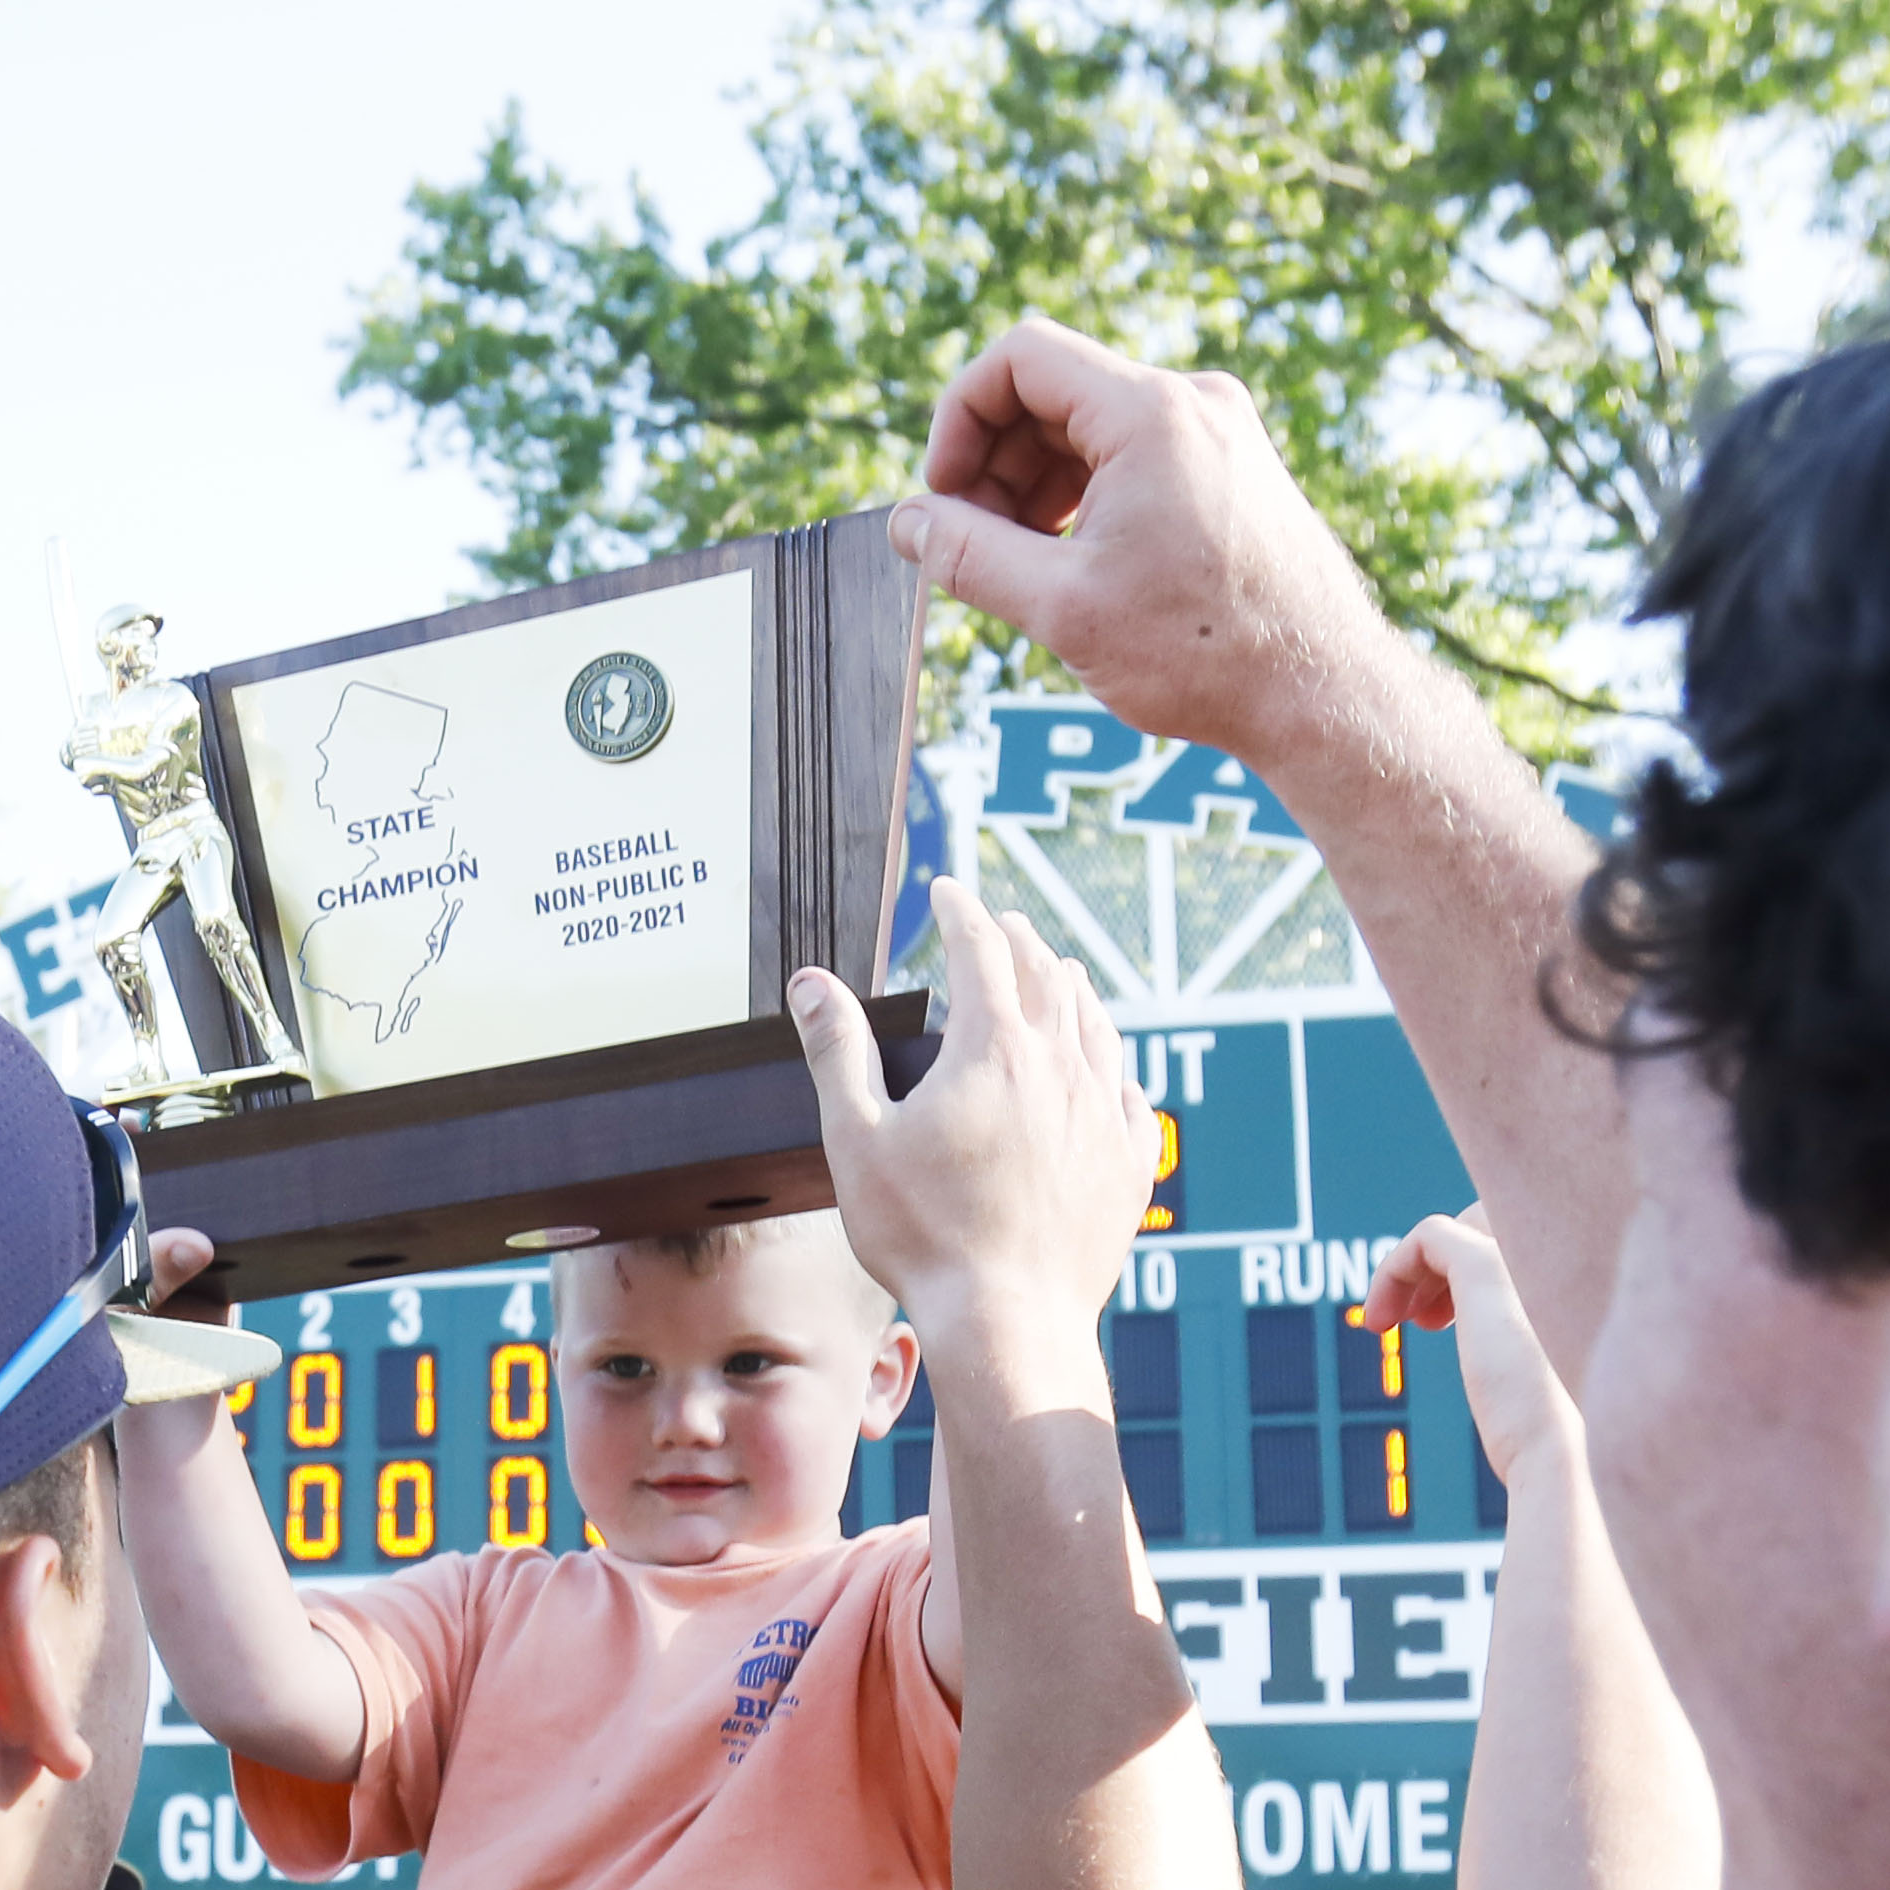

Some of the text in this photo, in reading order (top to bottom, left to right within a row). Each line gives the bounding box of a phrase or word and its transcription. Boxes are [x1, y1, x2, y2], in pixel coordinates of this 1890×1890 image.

[347, 805, 436, 845] STATE
[555, 829, 679, 875] BASEBALL
[316, 857, 479, 912] CHAMPION
[534, 859, 708, 915] NON-PUBLIC B
[562, 900, 685, 947] 2020-2021
[1123, 1031, 1216, 1106] UT
[298, 1292, 333, 1349] 2
[388, 1288, 423, 1345] 3
[501, 1283, 536, 1337] 4
[1120, 1252, 1177, 1312] 10
[287, 1352, 343, 1449] 0
[415, 1353, 437, 1438] 1
[489, 1343, 549, 1441] 0
[285, 1428, 1408, 1561] 0 0 0 1
[1225, 1780, 1453, 1877] OME
